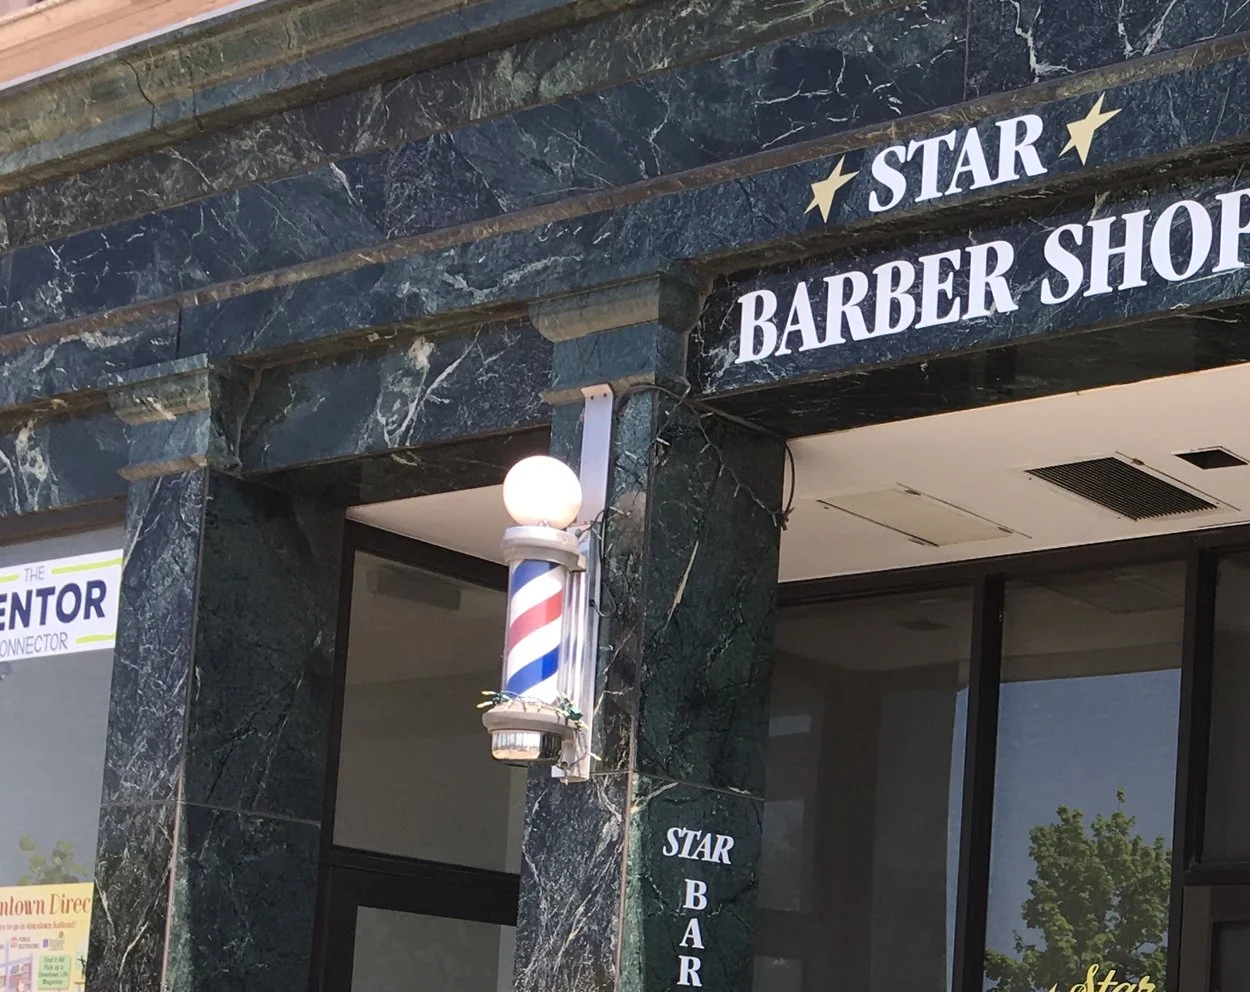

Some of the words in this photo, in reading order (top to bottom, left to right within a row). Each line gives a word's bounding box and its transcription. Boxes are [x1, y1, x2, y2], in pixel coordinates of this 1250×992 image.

[867, 113, 1048, 213] STAR
[735, 239, 1019, 365] BARBER
[24, 565, 45, 582] THE
[662, 826, 735, 866] STAR
